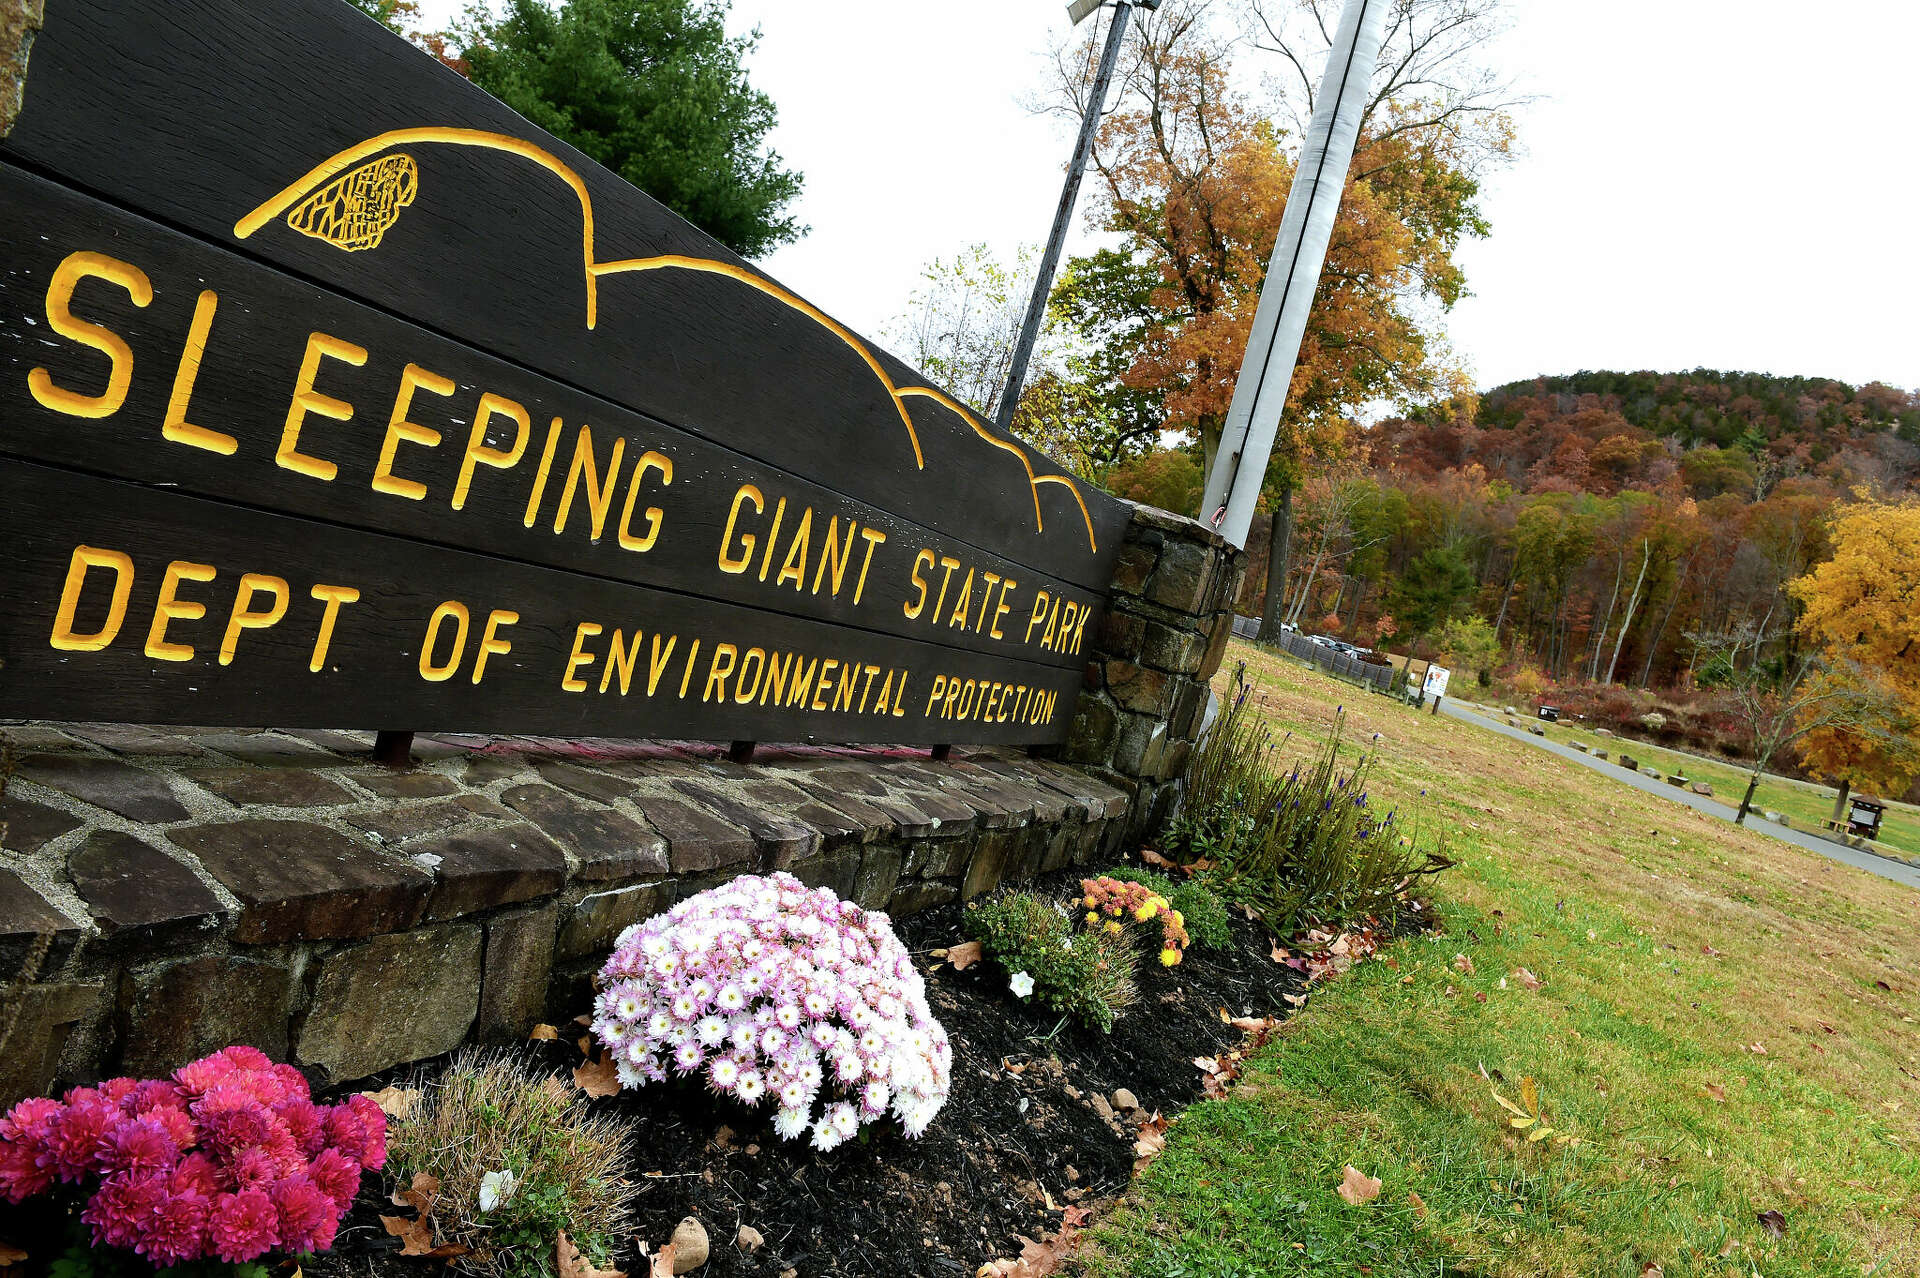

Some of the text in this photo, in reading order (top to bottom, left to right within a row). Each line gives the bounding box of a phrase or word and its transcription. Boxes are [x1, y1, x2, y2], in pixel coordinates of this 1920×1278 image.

[27, 251, 1090, 656] SLEEPING GIANT STATE PARK
[49, 545, 1057, 726] DEPT OF ENVIRONMENTAL PROTECTION
